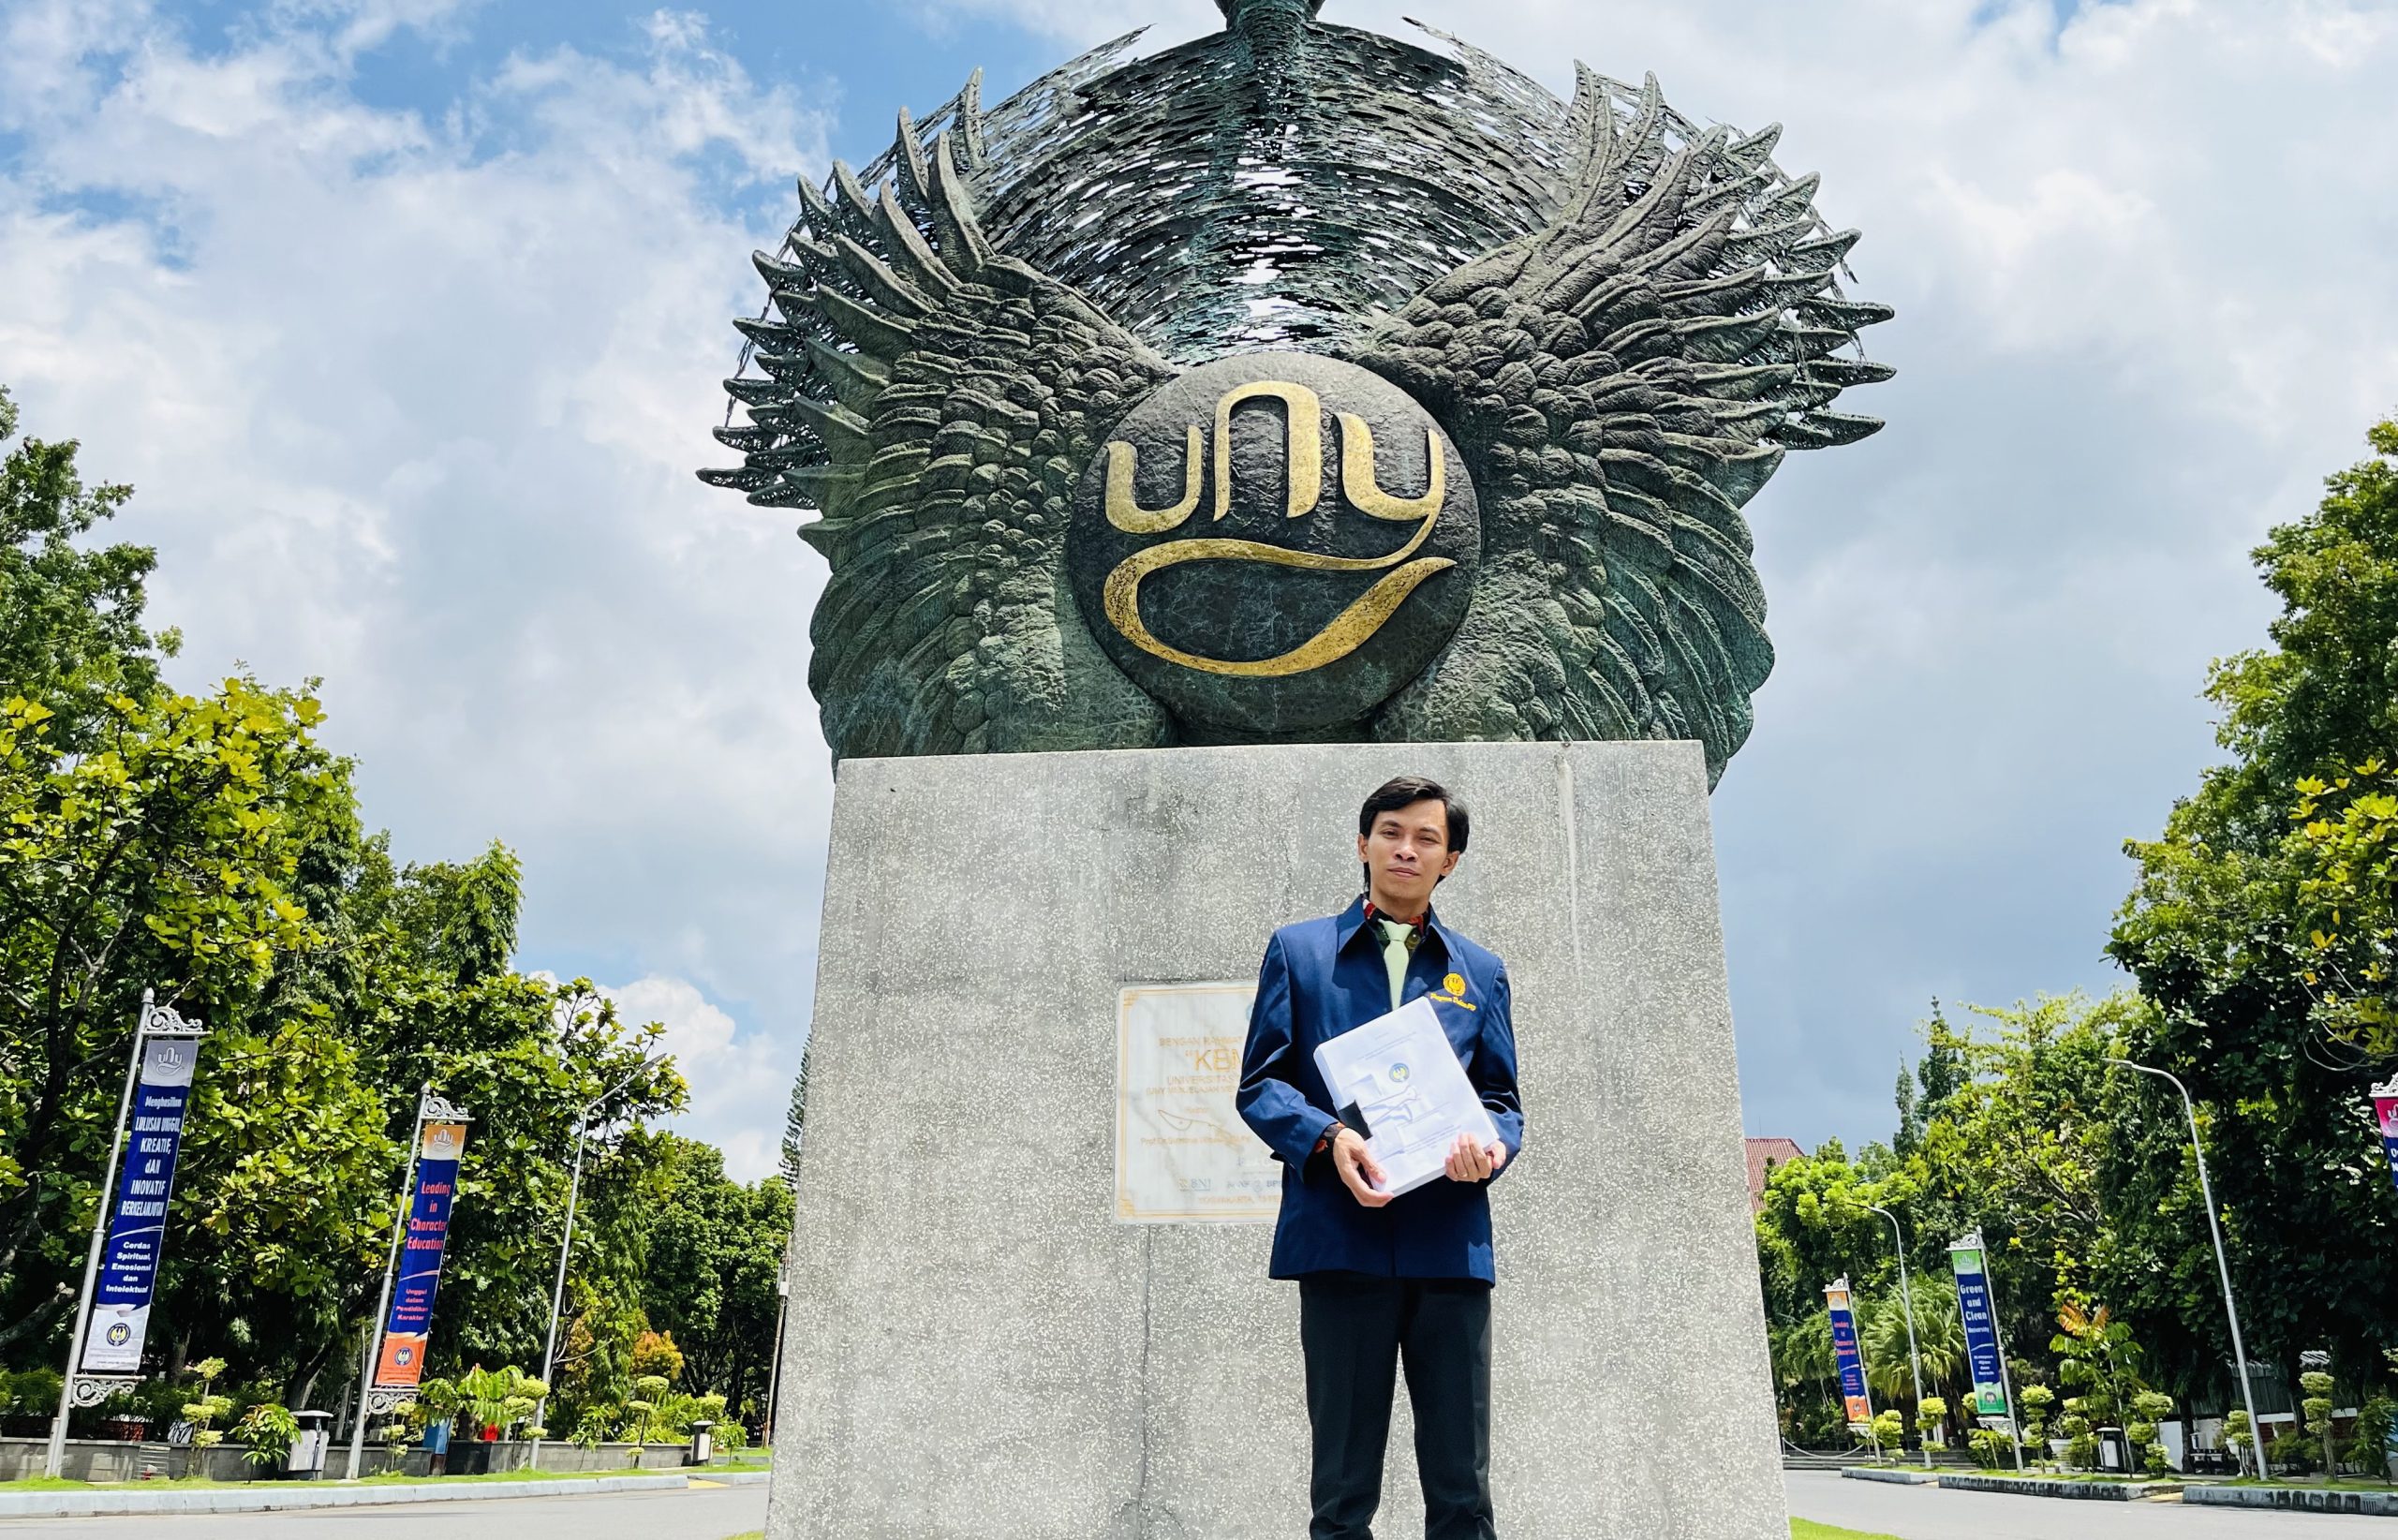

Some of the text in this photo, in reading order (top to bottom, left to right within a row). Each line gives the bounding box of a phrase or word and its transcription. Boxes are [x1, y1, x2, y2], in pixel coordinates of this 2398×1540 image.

[135, 1117, 161, 1132] LULUSAN
[141, 1138, 171, 1154] KREATIF,
[130, 1180, 166, 1195] INOVATIF
[422, 1181, 451, 1197] Leading
[429, 1200, 437, 1212] in
[410, 1218, 448, 1231] Character
[407, 1237, 444, 1250] Education
[106, 1284, 148, 1293] Intelektual
[1960, 1284, 1983, 1294] Green
[1967, 1297, 1981, 1307] and
[1966, 1311, 1987, 1321] Clean
